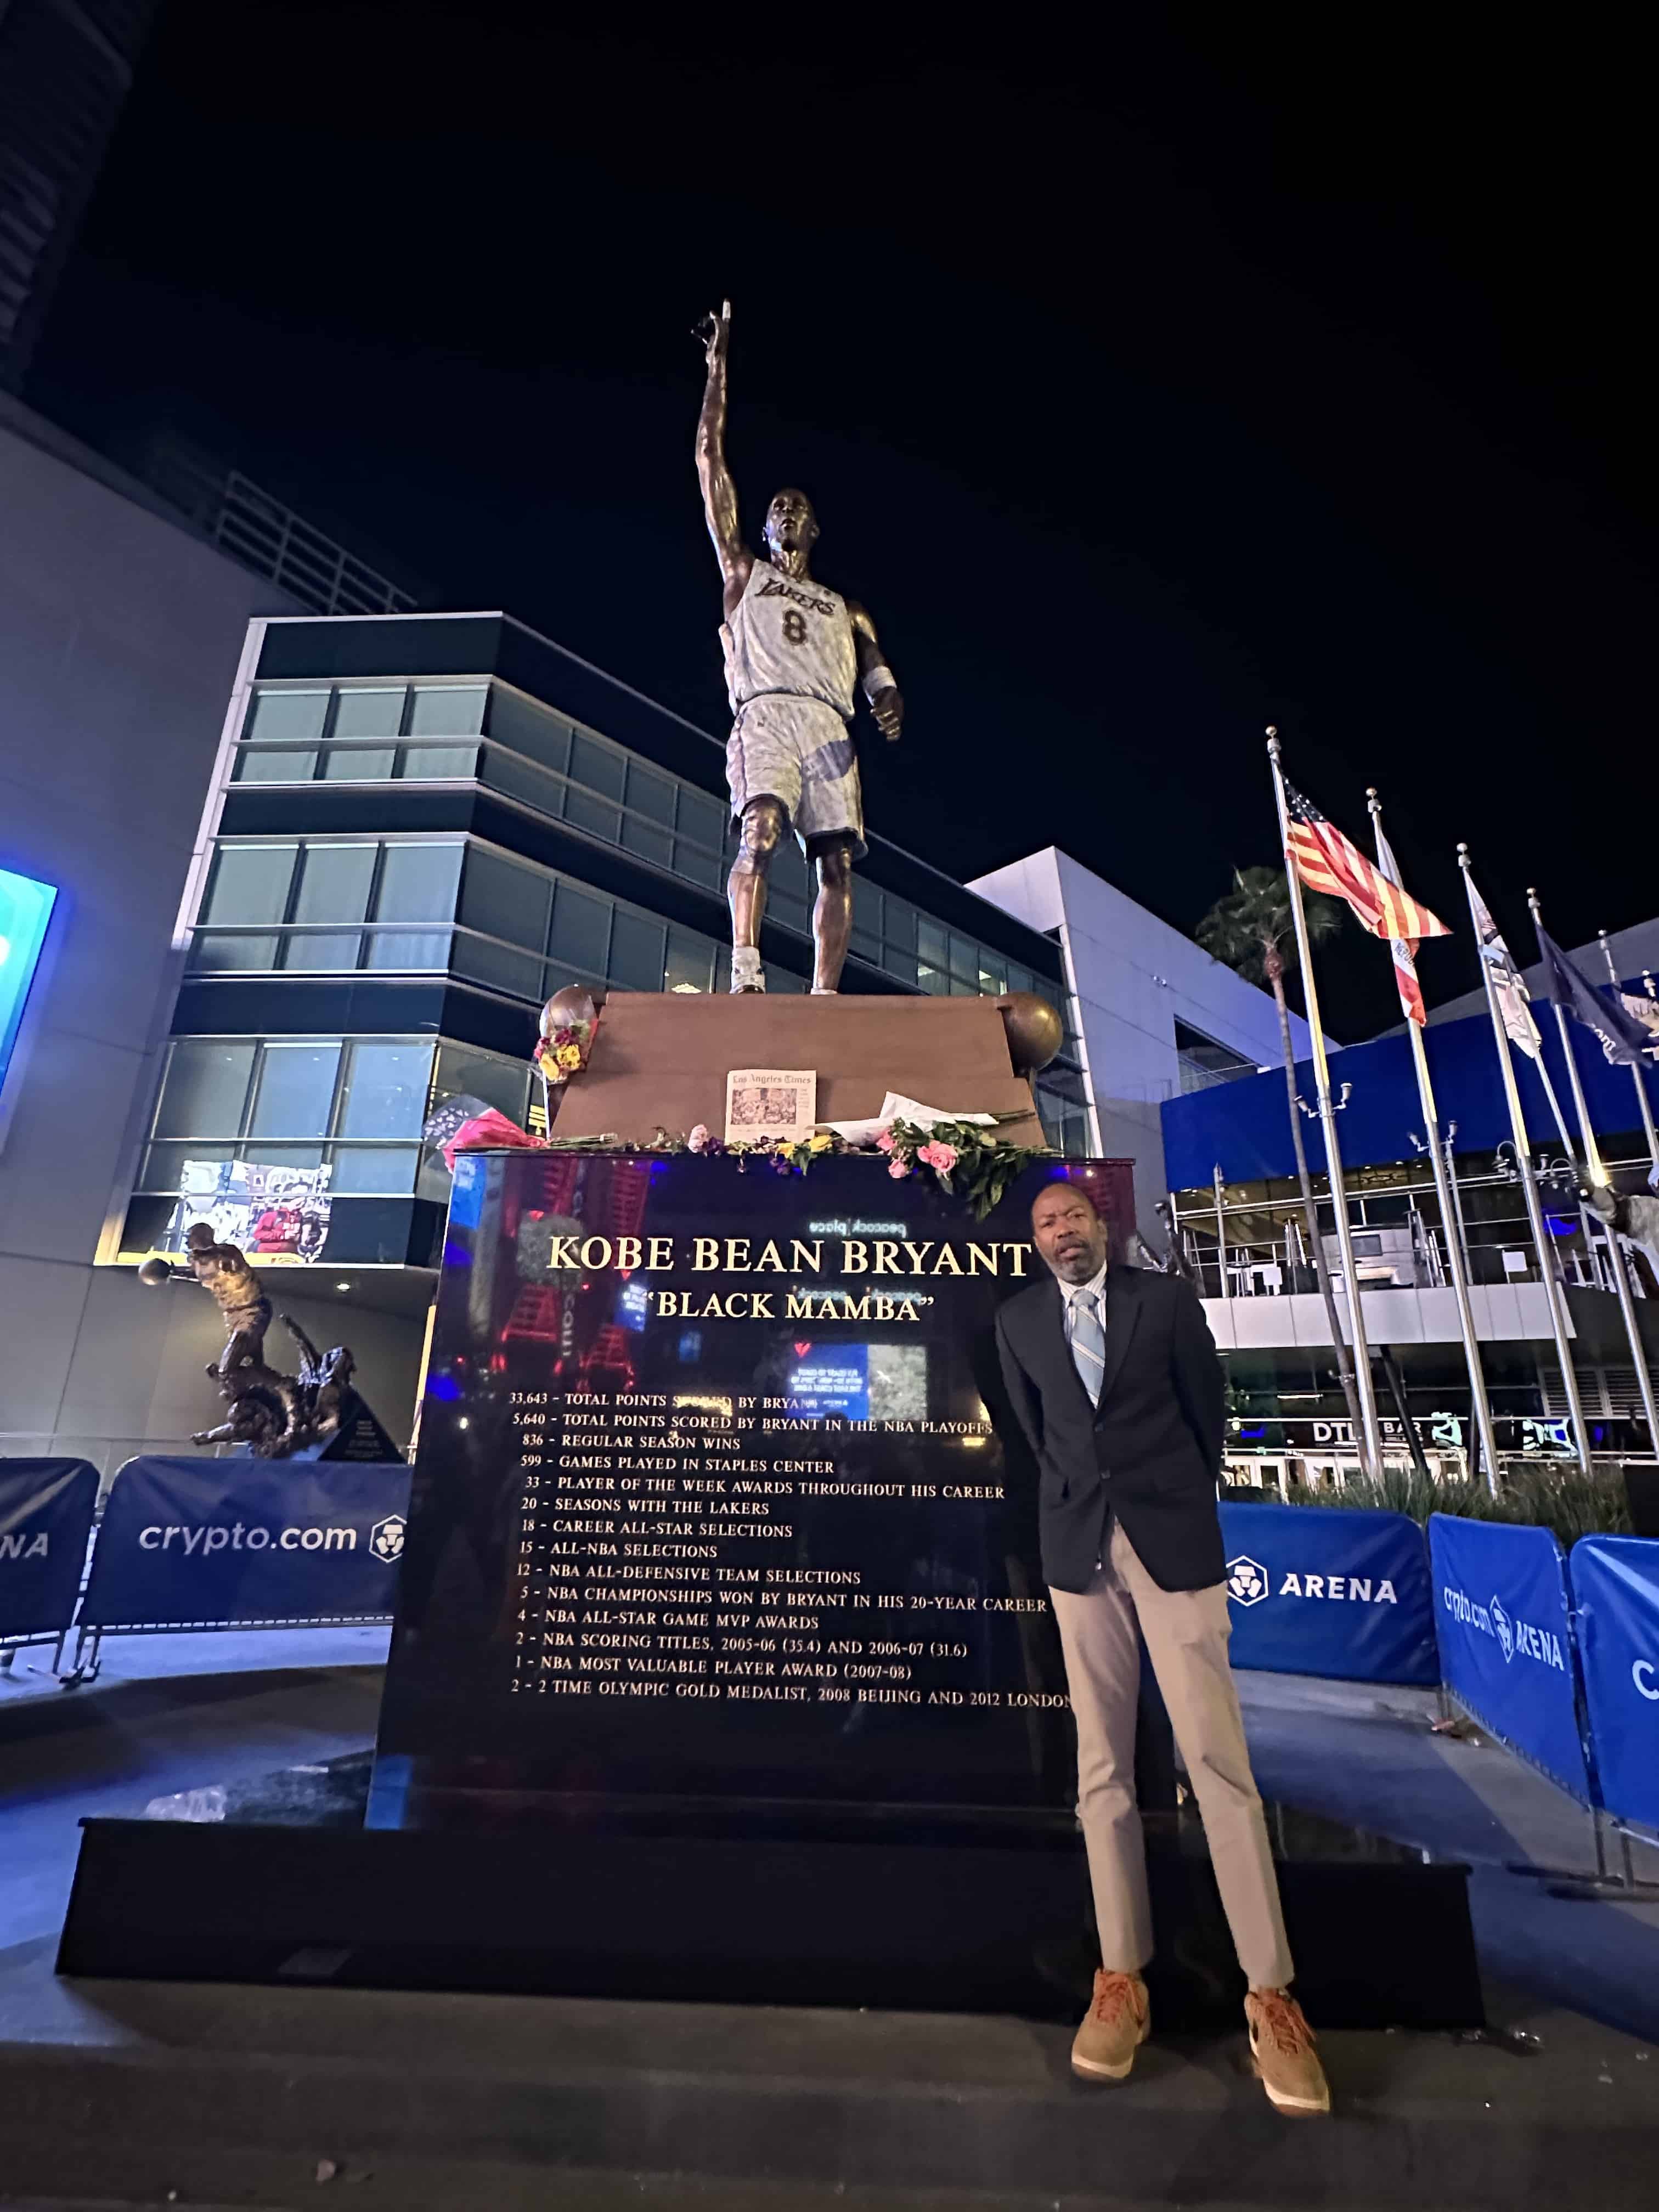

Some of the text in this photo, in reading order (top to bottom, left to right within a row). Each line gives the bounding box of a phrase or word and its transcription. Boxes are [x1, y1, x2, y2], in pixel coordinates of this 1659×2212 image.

[783, 610, 807, 645] 8
[733, 1074, 811, 1084] Los Angeles Times
[546, 1236, 1031, 1276] KOBE BEAN BRYANT
[509, 1392, 548, 1404] 33,643
[565, 1393, 610, 1405] TOTAL
[616, 1394, 667, 1406] POINTS
[738, 1397, 757, 1408] BY
[512, 1413, 545, 1425] 5,640
[562, 1414, 608, 1426] TOTAL
[614, 1414, 665, 1427] POINTS
[671, 1415, 733, 1429] SCORED
[737, 1417, 756, 1429] BY
[762, 1418, 820, 1431] BRYANT
[825, 1419, 842, 1431] IN
[848, 1420, 878, 1432] THE
[884, 1420, 914, 1432] NBA
[921, 1421, 993, 1434] PLAYOFFS
[522, 1434, 544, 1446] 836
[562, 1434, 634, 1448] REGULAR
[640, 1437, 696, 1448] SEASON
[702, 1437, 740, 1450] WINS
[520, 1455, 541, 1466] 599
[559, 1455, 611, 1468] GAMES
[618, 1457, 676, 1470] PLAYED
[682, 1458, 699, 1470] IN
[706, 1459, 767, 1472] STAPLES
[773, 1460, 834, 1474] CENTER
[525, 1476, 540, 1488] 33
[557, 1477, 615, 1490] PLAYER
[620, 1478, 641, 1490] OF
[645, 1479, 675, 1491] THE
[682, 1480, 726, 1492] WEEK
[731, 1481, 793, 1494] AWARDS
[798, 1482, 905, 1496] THROUGHOUT
[911, 1485, 936, 1497] HIS
[943, 1486, 1005, 1499] CAREER
[521, 1497, 537, 1509] 20
[555, 1498, 621, 1511] SEASONS
[628, 1499, 666, 1513] WITH
[672, 1500, 702, 1513] THE
[710, 1502, 769, 1515] LAKERS
[523, 1519, 534, 1531] 18
[553, 1520, 615, 1533] CAREER
[620, 1521, 693, 1535] ALL-STAR
[699, 1523, 792, 1537] SELECTIONS
[139, 1522, 357, 1556] crypto.com
[521, 1541, 533, 1553] 15
[550, 1542, 618, 1555] ALL-NBA
[624, 1543, 717, 1558] SELECTIONS
[517, 1563, 530, 1576] 12
[550, 1564, 580, 1577] NBA
[586, 1565, 710, 1581] ALL-DEFENSIVE
[716, 1568, 759, 1582] TEAM
[766, 1570, 861, 1584] SELECTIONS
[521, 1585, 528, 1599] 5
[548, 1587, 578, 1600] NBA
[584, 1588, 712, 1604] CHAMPIONSHIPS
[719, 1591, 753, 1604] WON
[761, 1592, 781, 1605] BY
[787, 1593, 847, 1606] BRYANT
[854, 1594, 870, 1607] IN
[878, 1595, 904, 1608] HIS
[911, 1596, 977, 1610] 20-YEAR
[983, 1598, 1047, 1612] CAREER
[1279, 1573, 1397, 1605] ARENA
[517, 1609, 526, 1621] 4
[545, 1610, 576, 1623] NBA
[582, 1610, 656, 1624] ALL-STAR
[663, 1612, 709, 1627] GAME
[716, 1614, 750, 1627] MVP
[755, 1615, 819, 1629] AWARDS
[516, 1632, 523, 1645] 2
[543, 1632, 574, 1646] NBA
[580, 1634, 651, 1648] SCORING
[721, 1638, 776, 1651] 2005-06
[782, 1638, 821, 1654] (35.4)
[827, 1641, 862, 1654] AND
[869, 1641, 923, 1655] 2006-07
[930, 1642, 967, 1657] (31.6)
[516, 1655, 521, 1668] 1
[540, 1656, 572, 1670] NBA
[579, 1657, 621, 1671] MOST
[627, 1658, 707, 1673] VALUABLE
[715, 1661, 775, 1675] PLAYER
[781, 1663, 837, 1677] AWARD
[844, 1663, 911, 1680] (2007-08)
[511, 1679, 519, 1692] 2
[539, 1679, 546, 1693] 2
[552, 1680, 591, 1694] TIME
[599, 1681, 669, 1696] OLYMPIC
[675, 1683, 720, 1697] GOLD
[727, 1685, 810, 1701] MEDALIST,
[818, 1688, 850, 1701] 2008
[858, 1689, 921, 1703] BEIJING
[928, 1691, 963, 1705] AND
[970, 1692, 1000, 1706] 2012
